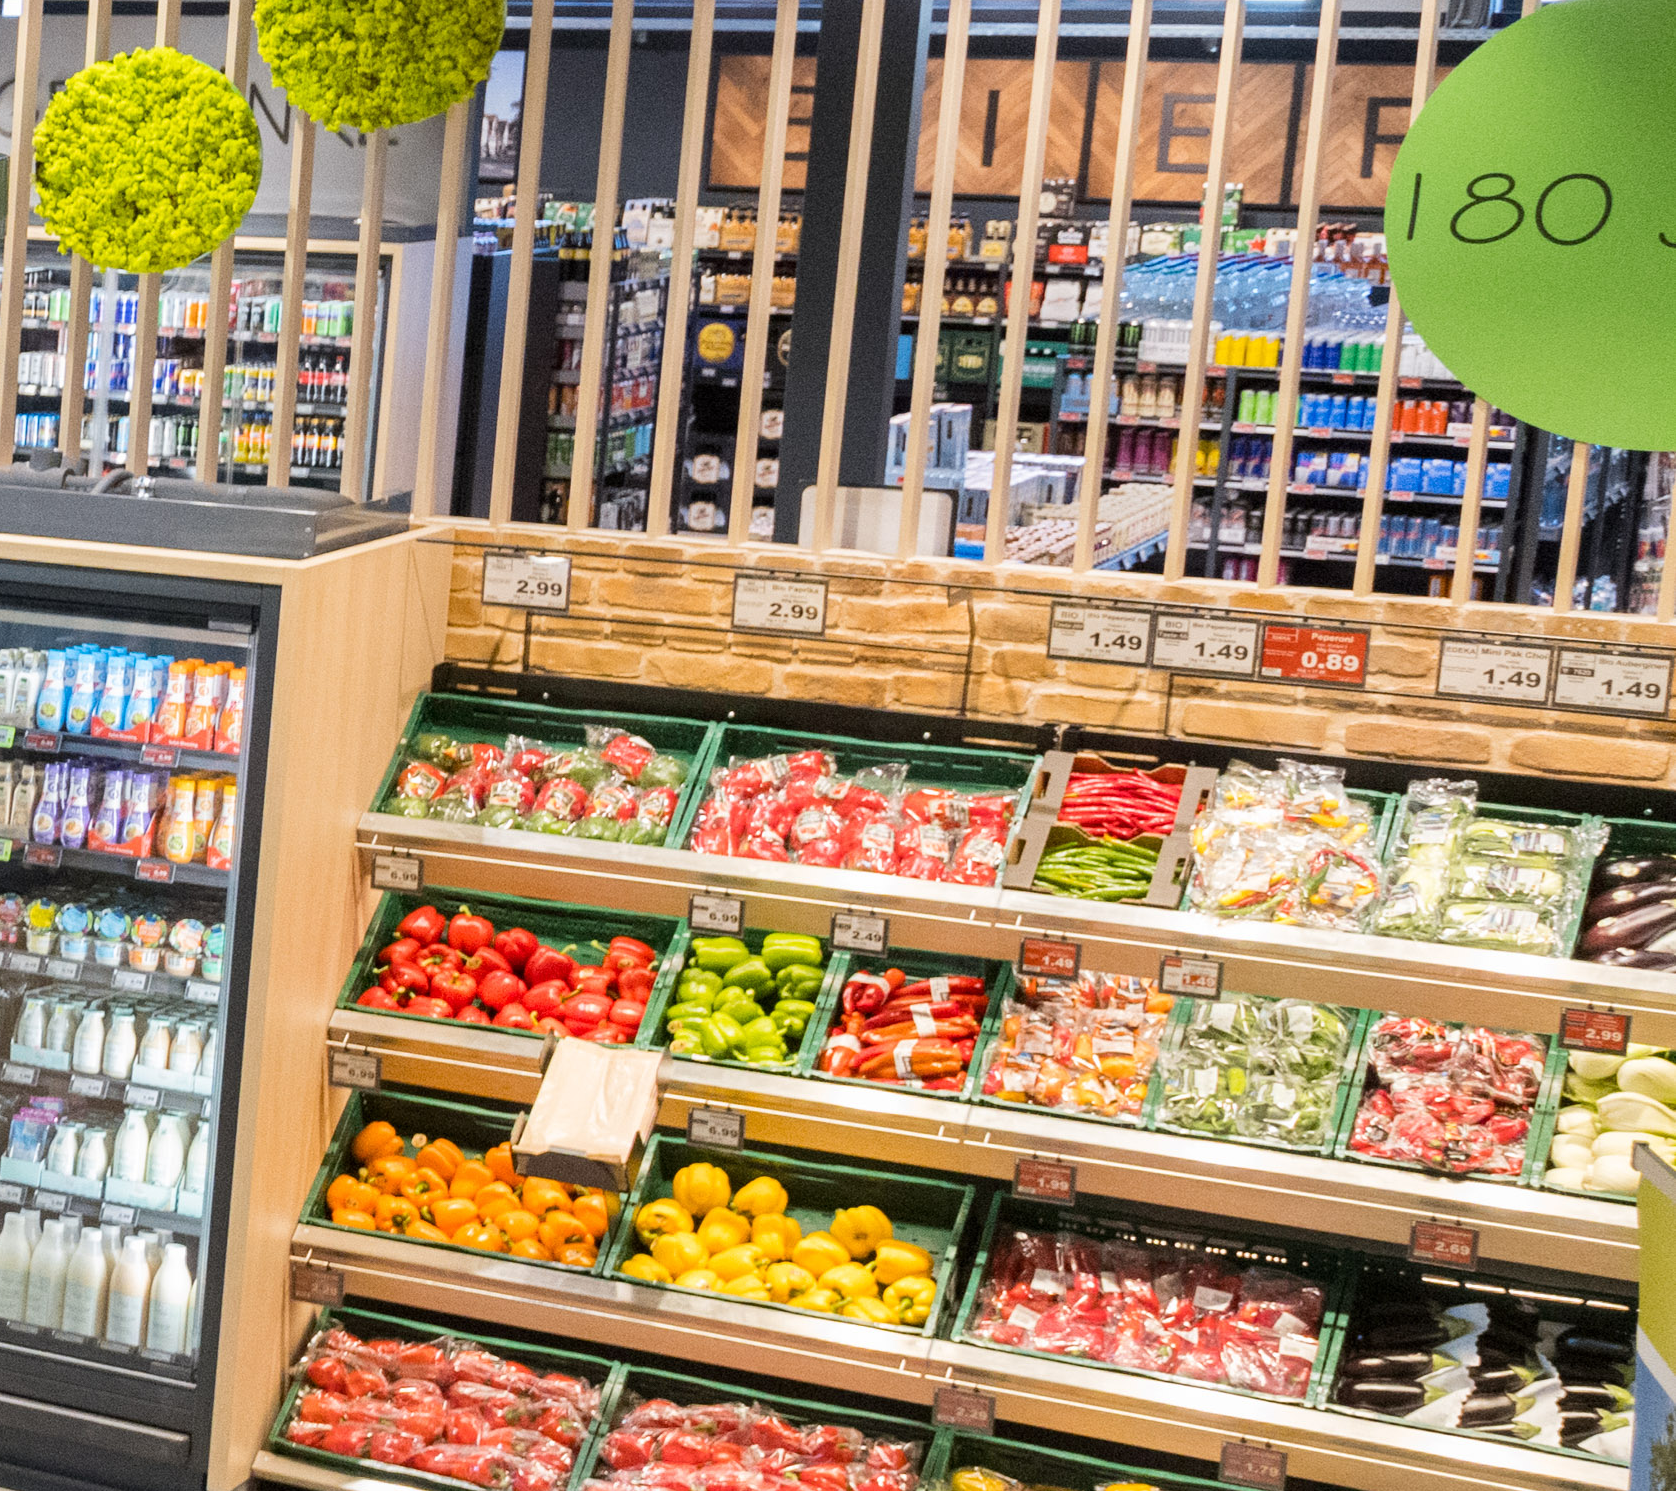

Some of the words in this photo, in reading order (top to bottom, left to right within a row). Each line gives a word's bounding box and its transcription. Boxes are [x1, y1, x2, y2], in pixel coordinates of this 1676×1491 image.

[1407, 173, 1613, 246] 180
[517, 579, 562, 597] 2.99
[769, 602, 819, 621] 2.99
[1089, 632, 1143, 651] 1.49
[1194, 642, 1249, 660] 1.49
[1301, 651, 1359, 672] 0.89
[1482, 669, 1541, 688] 1.49
[1601, 680, 1661, 698] 1.49
[709, 912, 739, 925] 6.99
[852, 930, 881, 942] 2.49
[1043, 955, 1074, 968] 1.49
[1585, 1030, 1623, 1044] 2.99
[708, 1126, 739, 1140] 6.99
